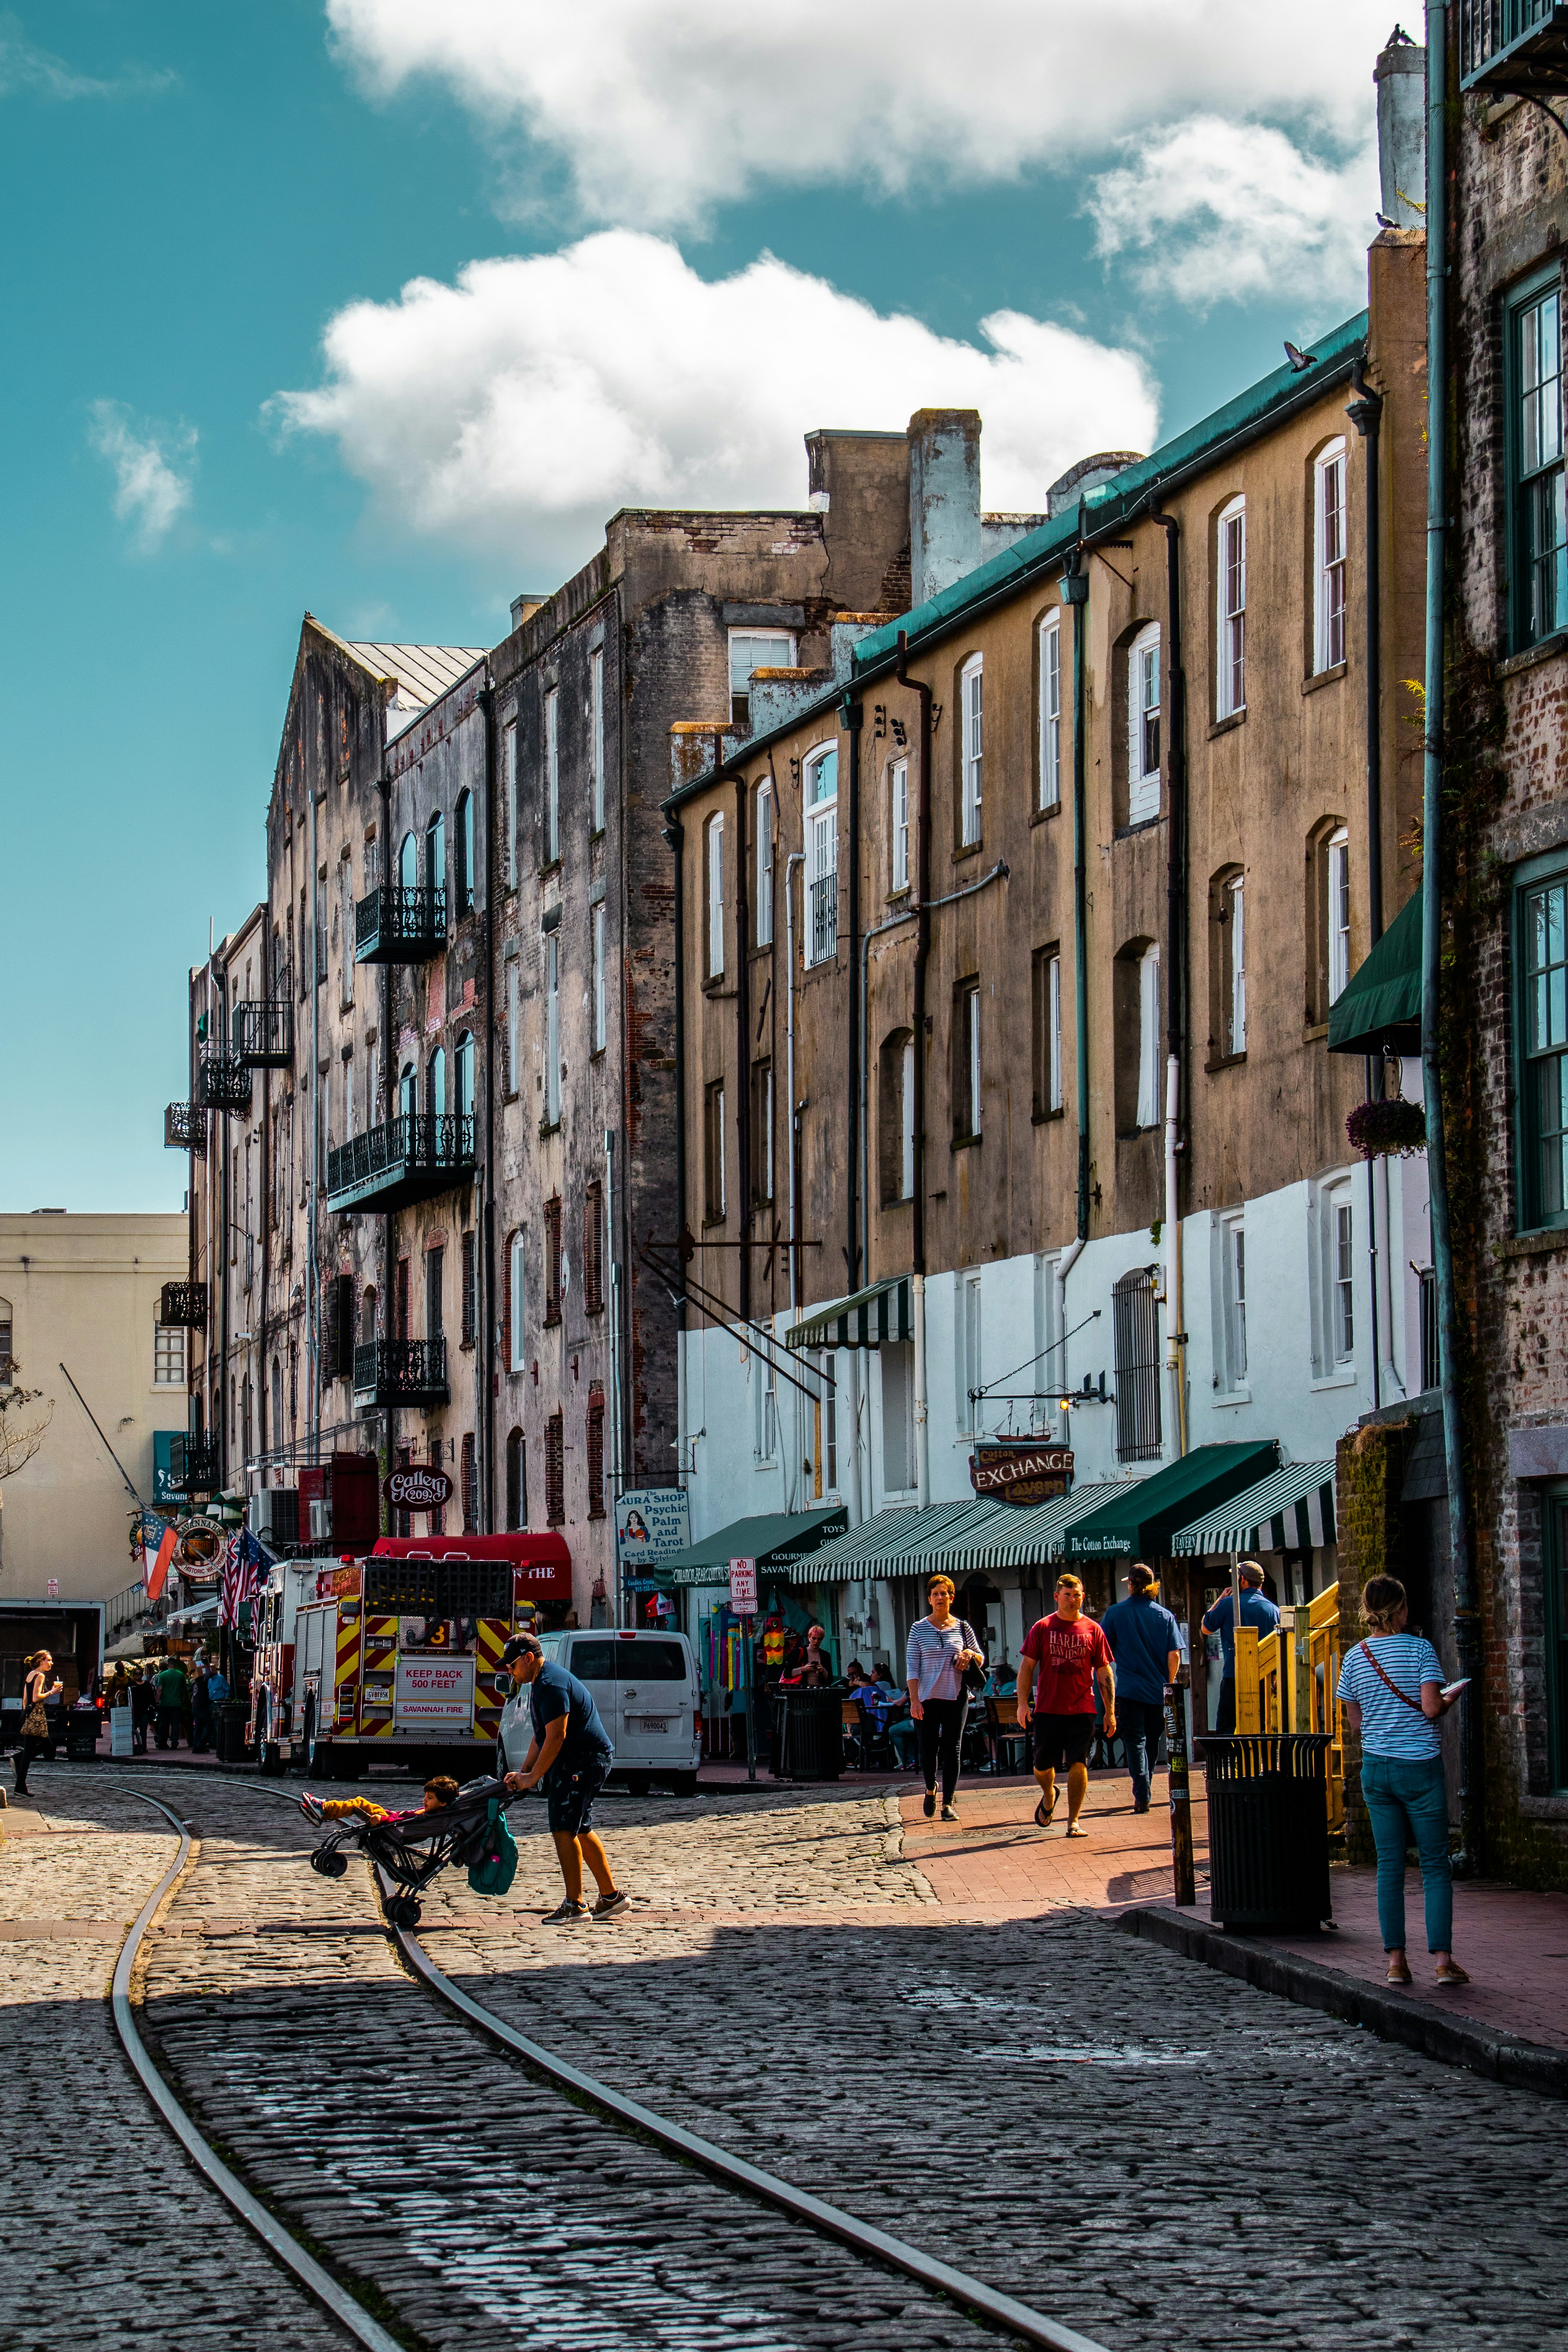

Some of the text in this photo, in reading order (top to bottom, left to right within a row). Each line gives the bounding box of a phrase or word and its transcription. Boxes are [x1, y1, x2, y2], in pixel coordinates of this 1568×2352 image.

[980, 1450, 1016, 1462] Cotton
[975, 1454, 1072, 1487] EXCHANGE
[390, 1470, 447, 1502] Gallery
[410, 1490, 429, 1499] 209
[654, 1494, 685, 1503] SHOP
[645, 1504, 687, 1515] Psychic
[178, 1519, 223, 1535] SAVANNAH'S
[652, 1516, 681, 1526] Palm
[131, 1523, 142, 1546] GRILL
[657, 1526, 678, 1536] and
[653, 1537, 683, 1547] Tarot
[1072, 1536, 1131, 1552] The Cotton Exchange
[1175, 1535, 1196, 1549] TAVERN
[184, 1565, 205, 1574] HISTORIC
[206, 1548, 227, 1572] WAERFRONT
[431, 1625, 445, 1644] 3
[1050, 1631, 1087, 1648] HARLEY
[1050, 1644, 1088, 1659] DAVIDSON
[406, 1670, 463, 1678] KEEP BACK
